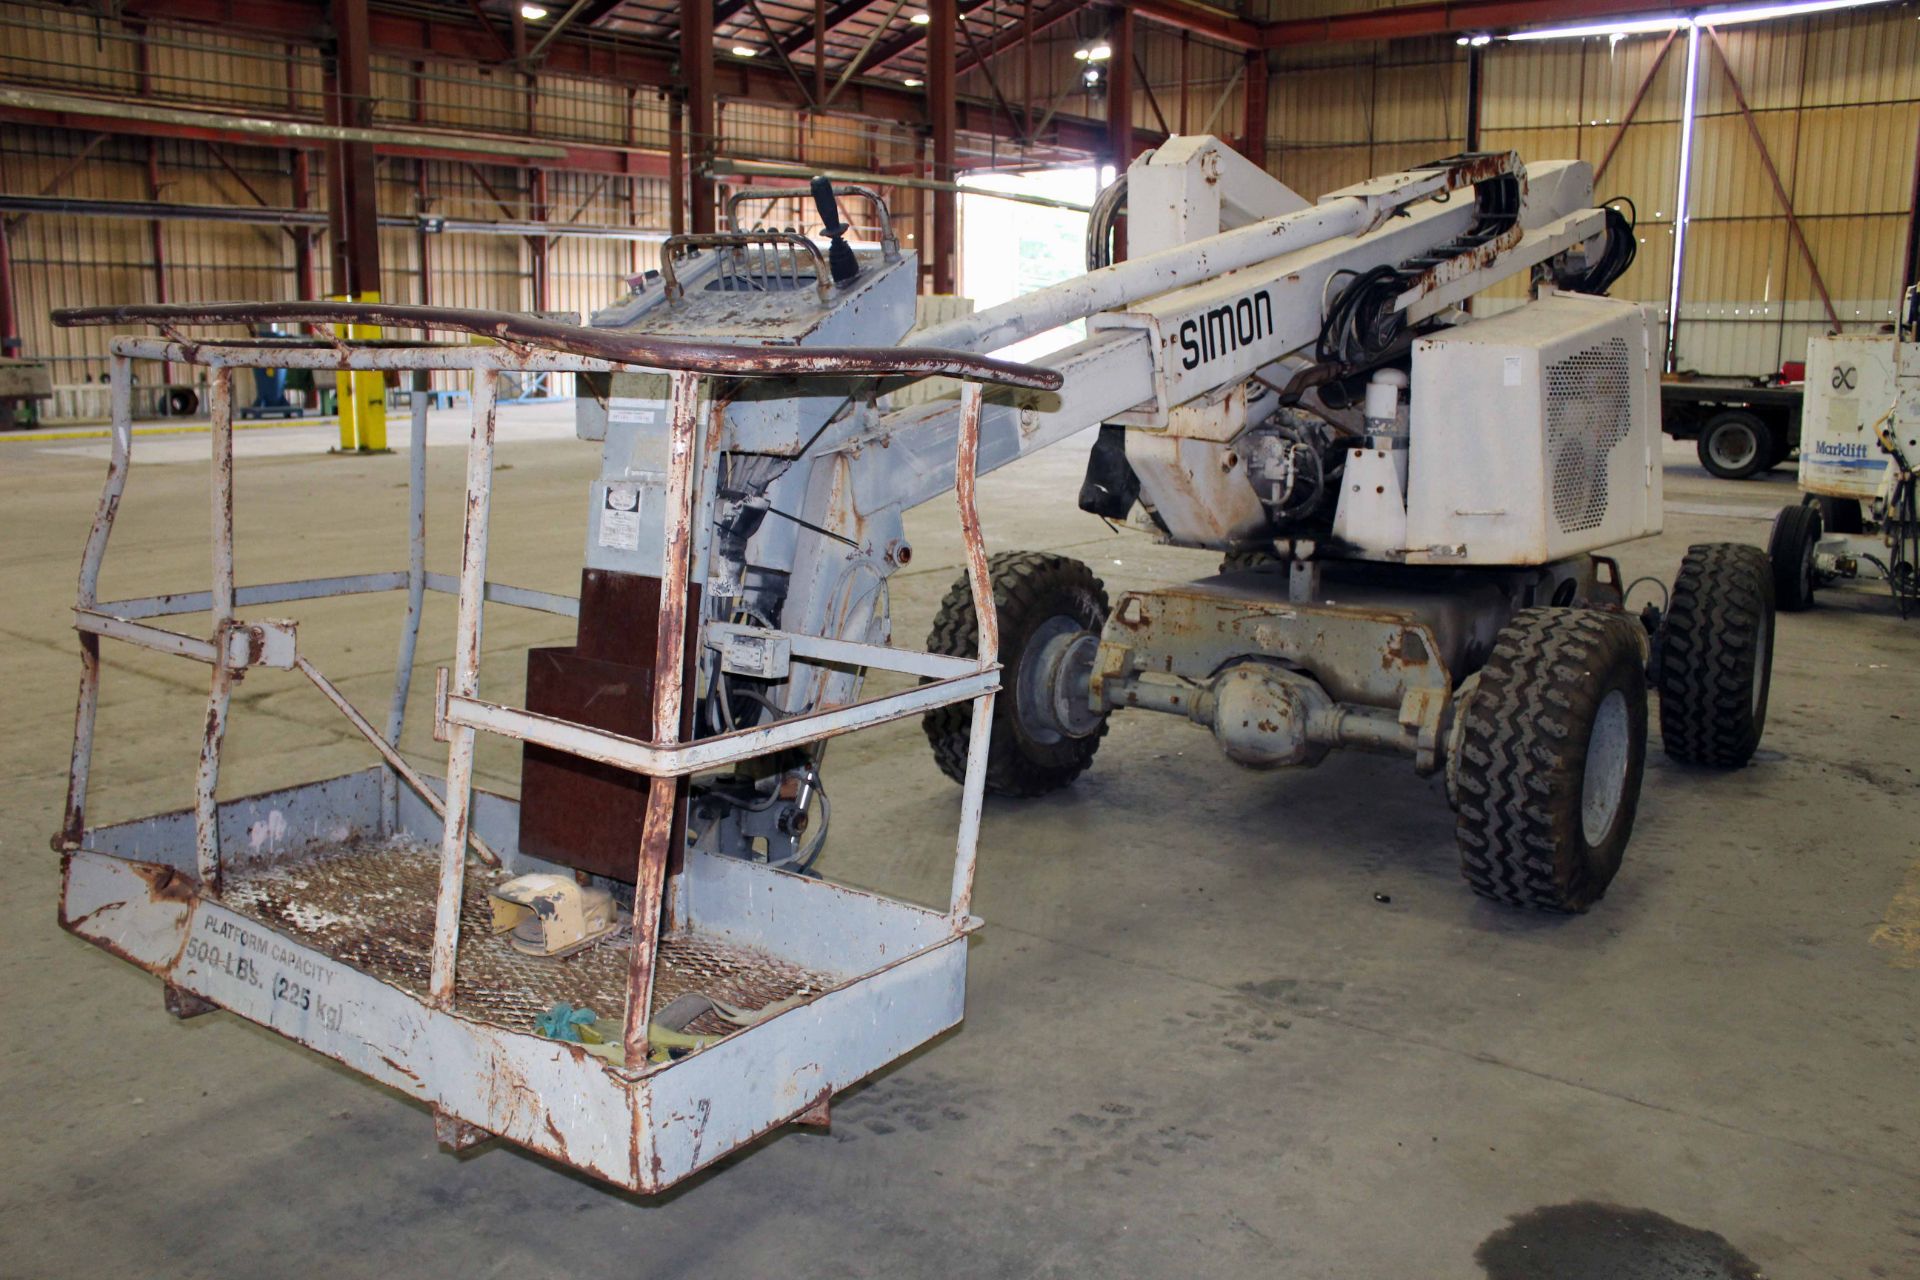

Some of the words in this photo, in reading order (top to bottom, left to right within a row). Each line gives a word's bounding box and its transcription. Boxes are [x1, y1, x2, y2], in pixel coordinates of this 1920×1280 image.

[1816, 440, 1868, 458] Marklift
[186, 936, 220, 968] 500
[272, 972, 311, 1011] (225
[204, 915, 269, 955] PLATFORM
[271, 944, 334, 985] CAPACITY
